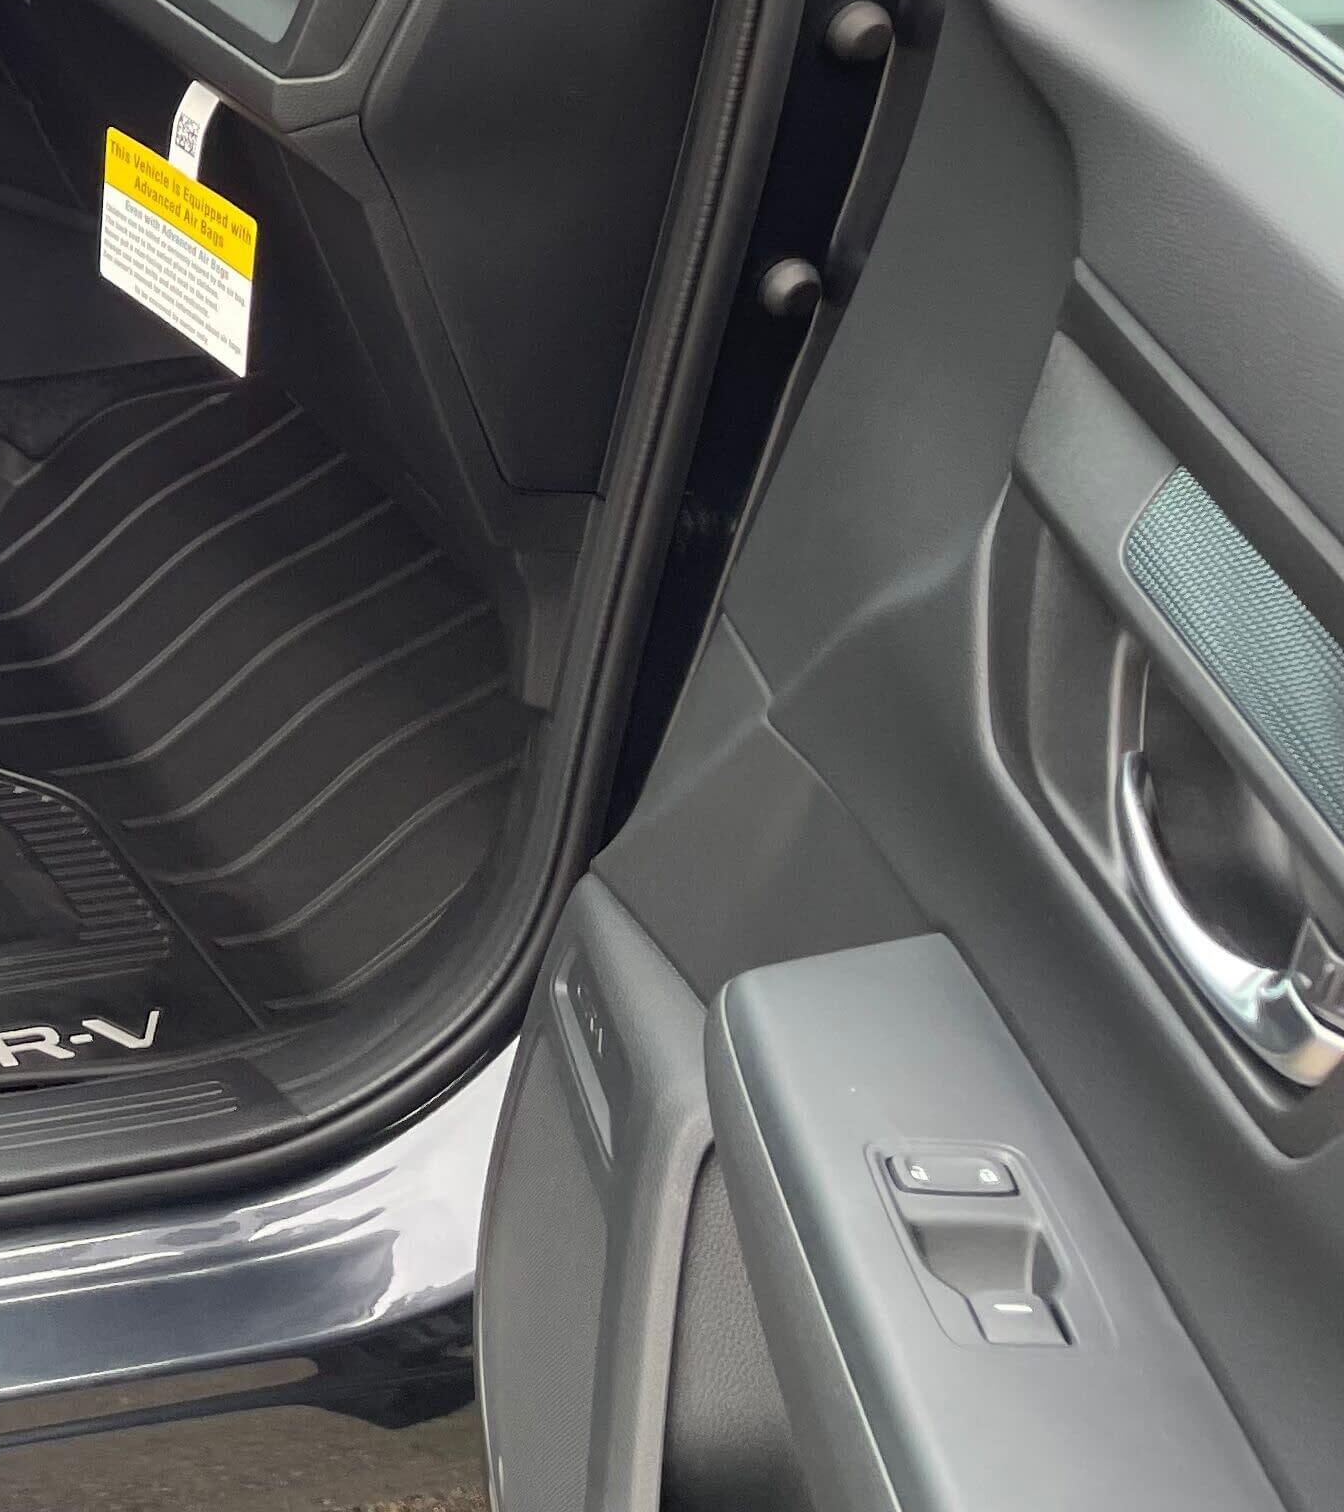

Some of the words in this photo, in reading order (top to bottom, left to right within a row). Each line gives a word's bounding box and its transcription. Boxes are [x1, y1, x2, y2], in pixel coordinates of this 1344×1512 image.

[110, 139, 130, 164] This
[134, 154, 169, 189] Vehicle
[183, 186, 229, 228] Equipped
[231, 223, 252, 245] with
[134, 176, 181, 217] Advanced
[183, 208, 198, 228] Air
[200, 219, 224, 248] Bags
